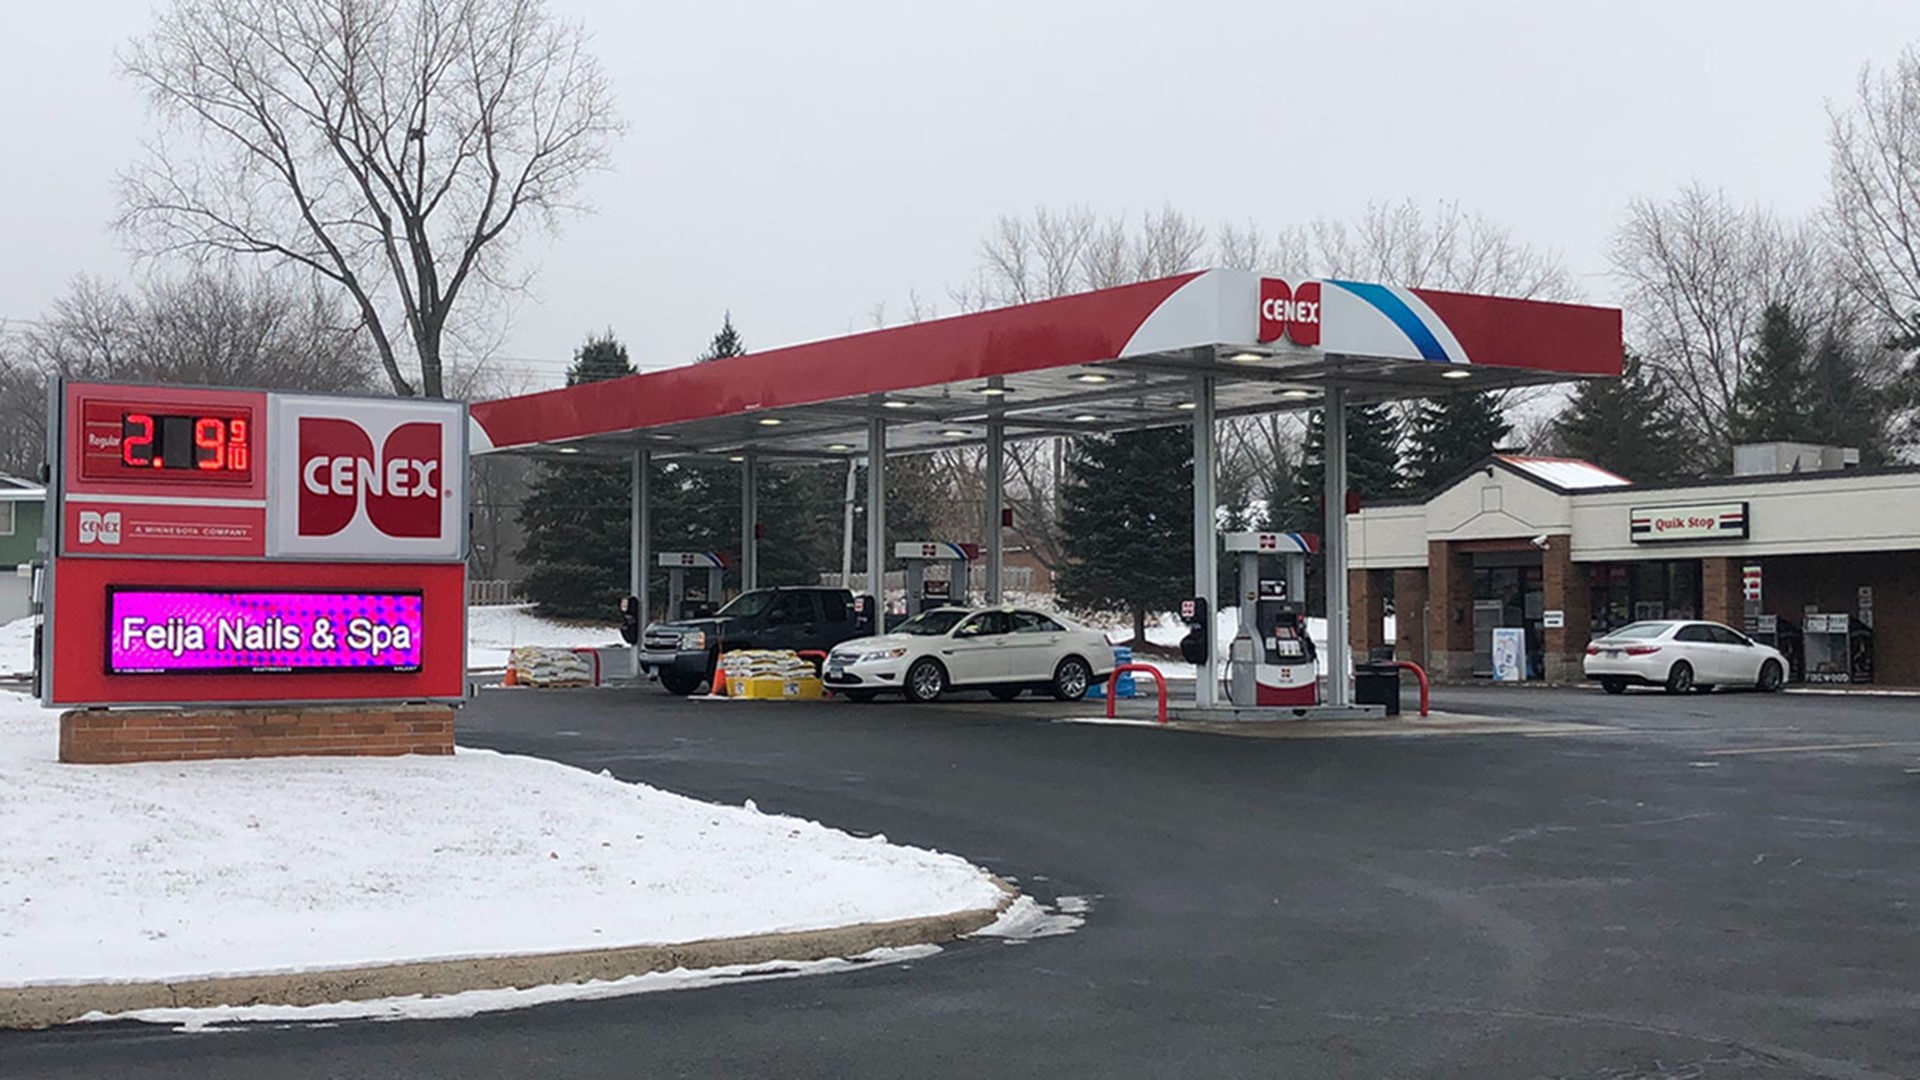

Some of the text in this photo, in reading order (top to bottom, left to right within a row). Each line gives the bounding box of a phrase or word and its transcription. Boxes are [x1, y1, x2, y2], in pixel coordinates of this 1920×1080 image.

[1262, 298, 1319, 323] CENEX
[88, 433, 121, 449] Regular
[303, 456, 438, 498] CENEX
[81, 520, 119, 533] CENEX
[134, 525, 248, 536] A MINNESOTA COMPANY
[1655, 516, 1715, 532] Quik Stop
[122, 617, 411, 657] Feija Nails & Spa
